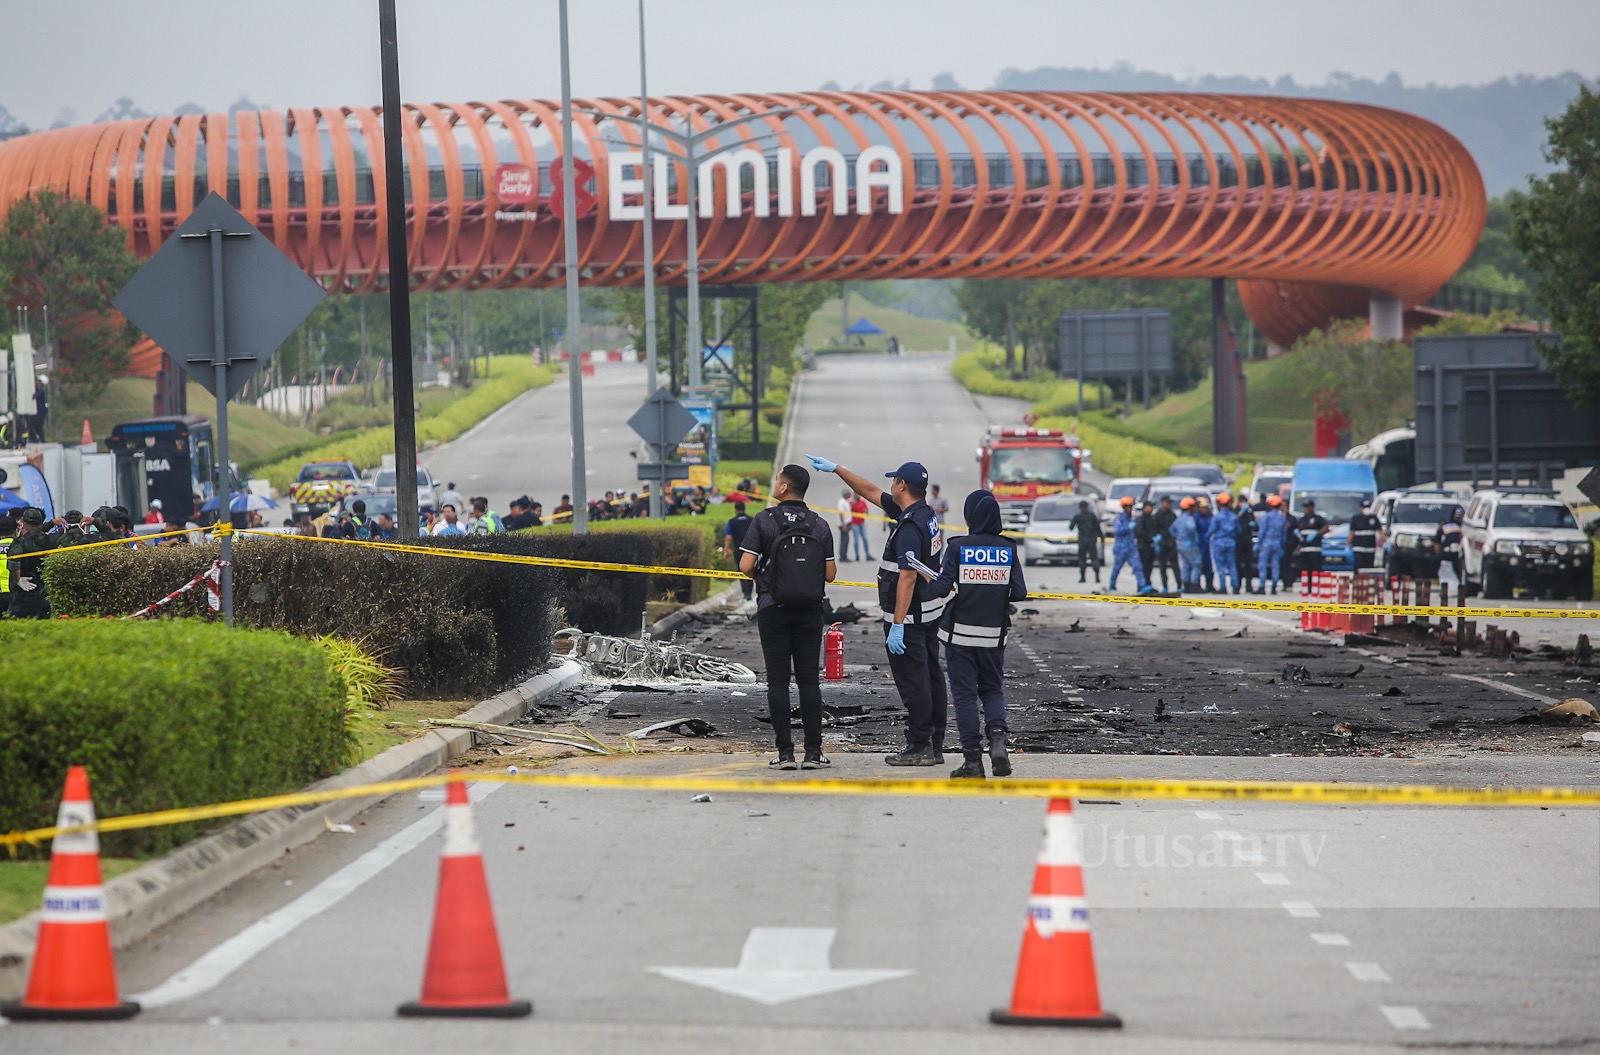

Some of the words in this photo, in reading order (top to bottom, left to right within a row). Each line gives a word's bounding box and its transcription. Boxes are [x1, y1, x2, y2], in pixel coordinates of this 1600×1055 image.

[501, 170, 530, 182] Sime
[608, 145, 904, 221] ELMINA
[499, 181, 533, 196] Darby
[494, 211, 537, 221] Property
[964, 548, 1009, 564] POLIS
[962, 568, 1007, 582] FORENSIK
